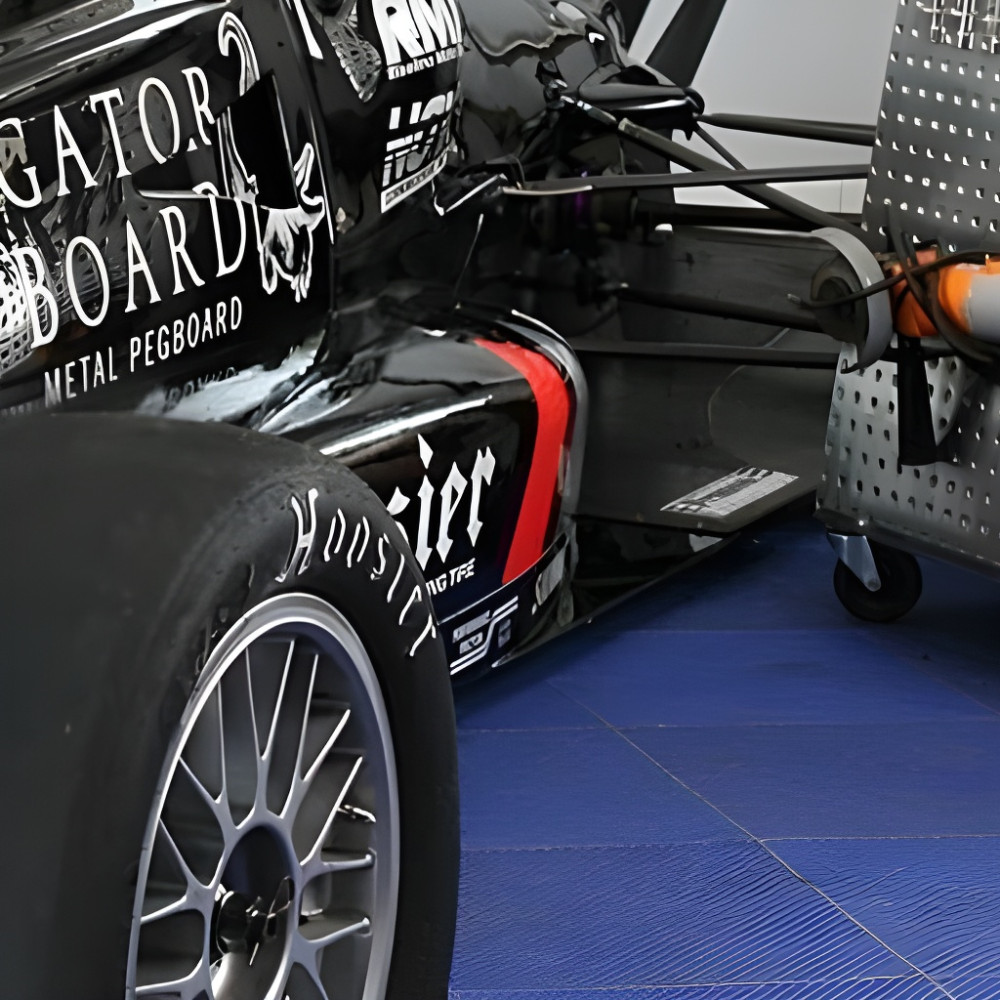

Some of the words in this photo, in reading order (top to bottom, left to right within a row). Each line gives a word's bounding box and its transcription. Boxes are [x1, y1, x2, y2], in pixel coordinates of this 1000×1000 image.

[0, 66, 216, 209] GATOR
[9, 181, 247, 349] BOARD
[44, 346, 118, 408] METAL
[130, 296, 243, 373] PEGBOARD
